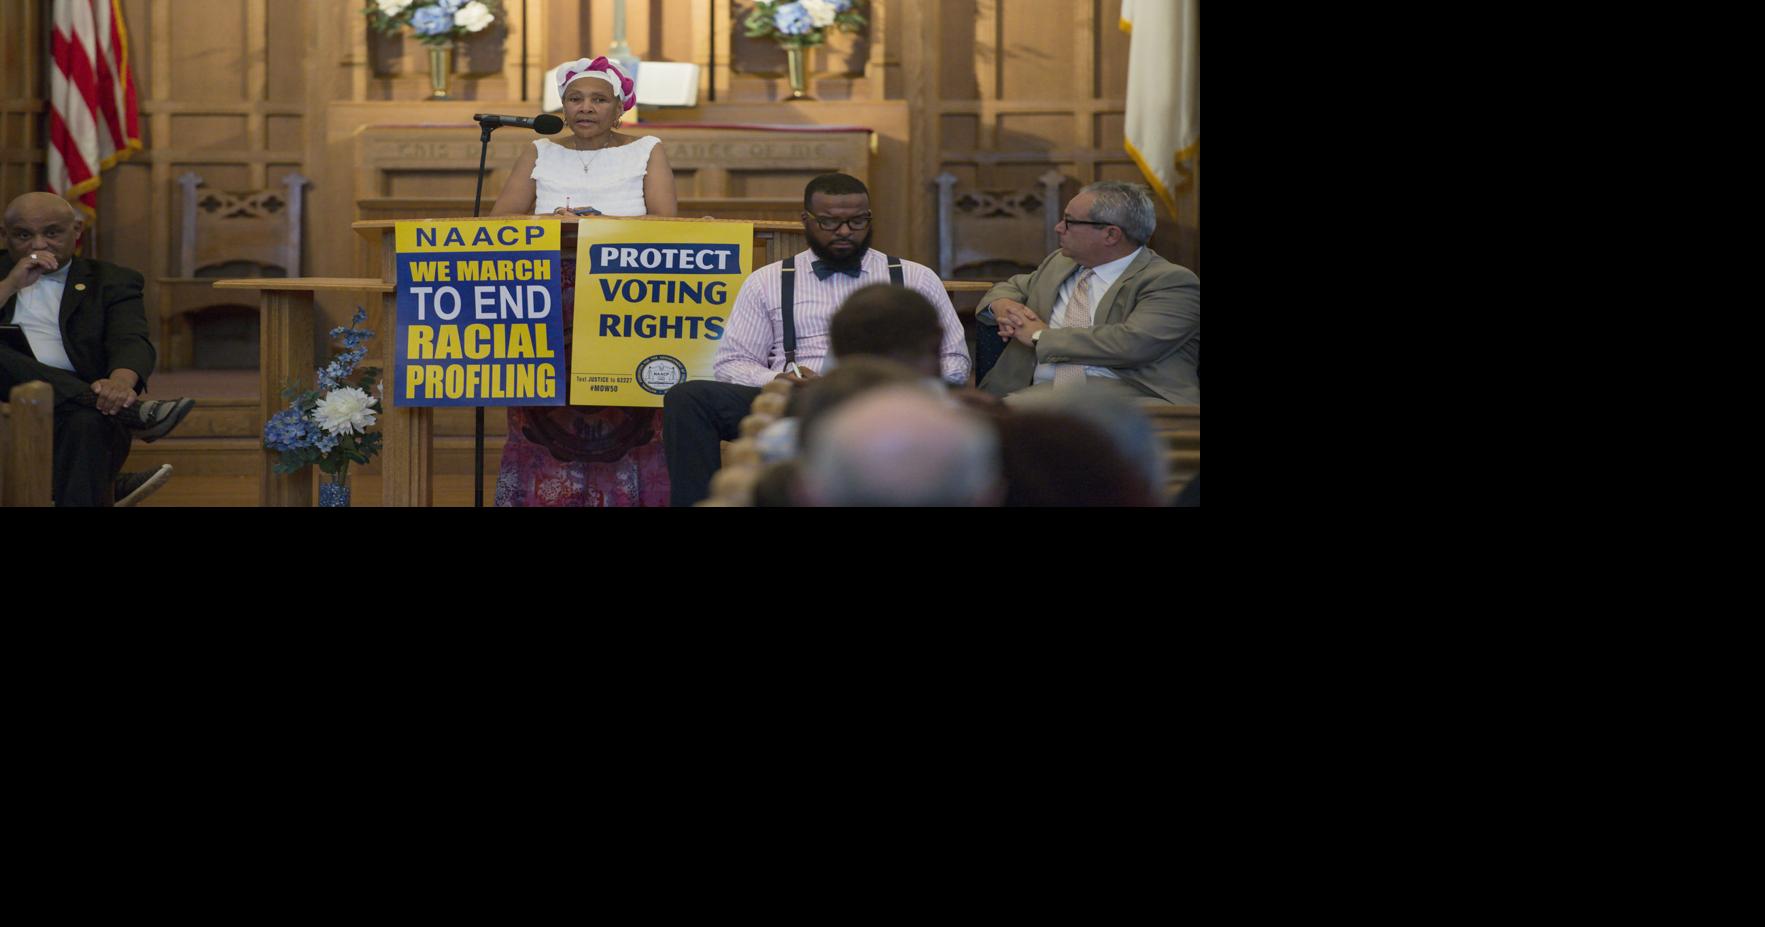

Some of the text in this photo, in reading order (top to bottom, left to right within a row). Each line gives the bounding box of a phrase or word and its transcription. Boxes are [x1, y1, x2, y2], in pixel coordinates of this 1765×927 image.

[416, 226, 545, 247] NAACP
[409, 259, 551, 282] WE MARCH
[600, 247, 731, 270] PROTECT
[410, 285, 551, 321] TO END
[599, 278, 727, 305] VOTING
[598, 313, 725, 341] RIGHTS
[407, 323, 555, 360] RACIAL
[405, 363, 556, 399] PROFILING
[590, 384, 618, 393] #MOW50
